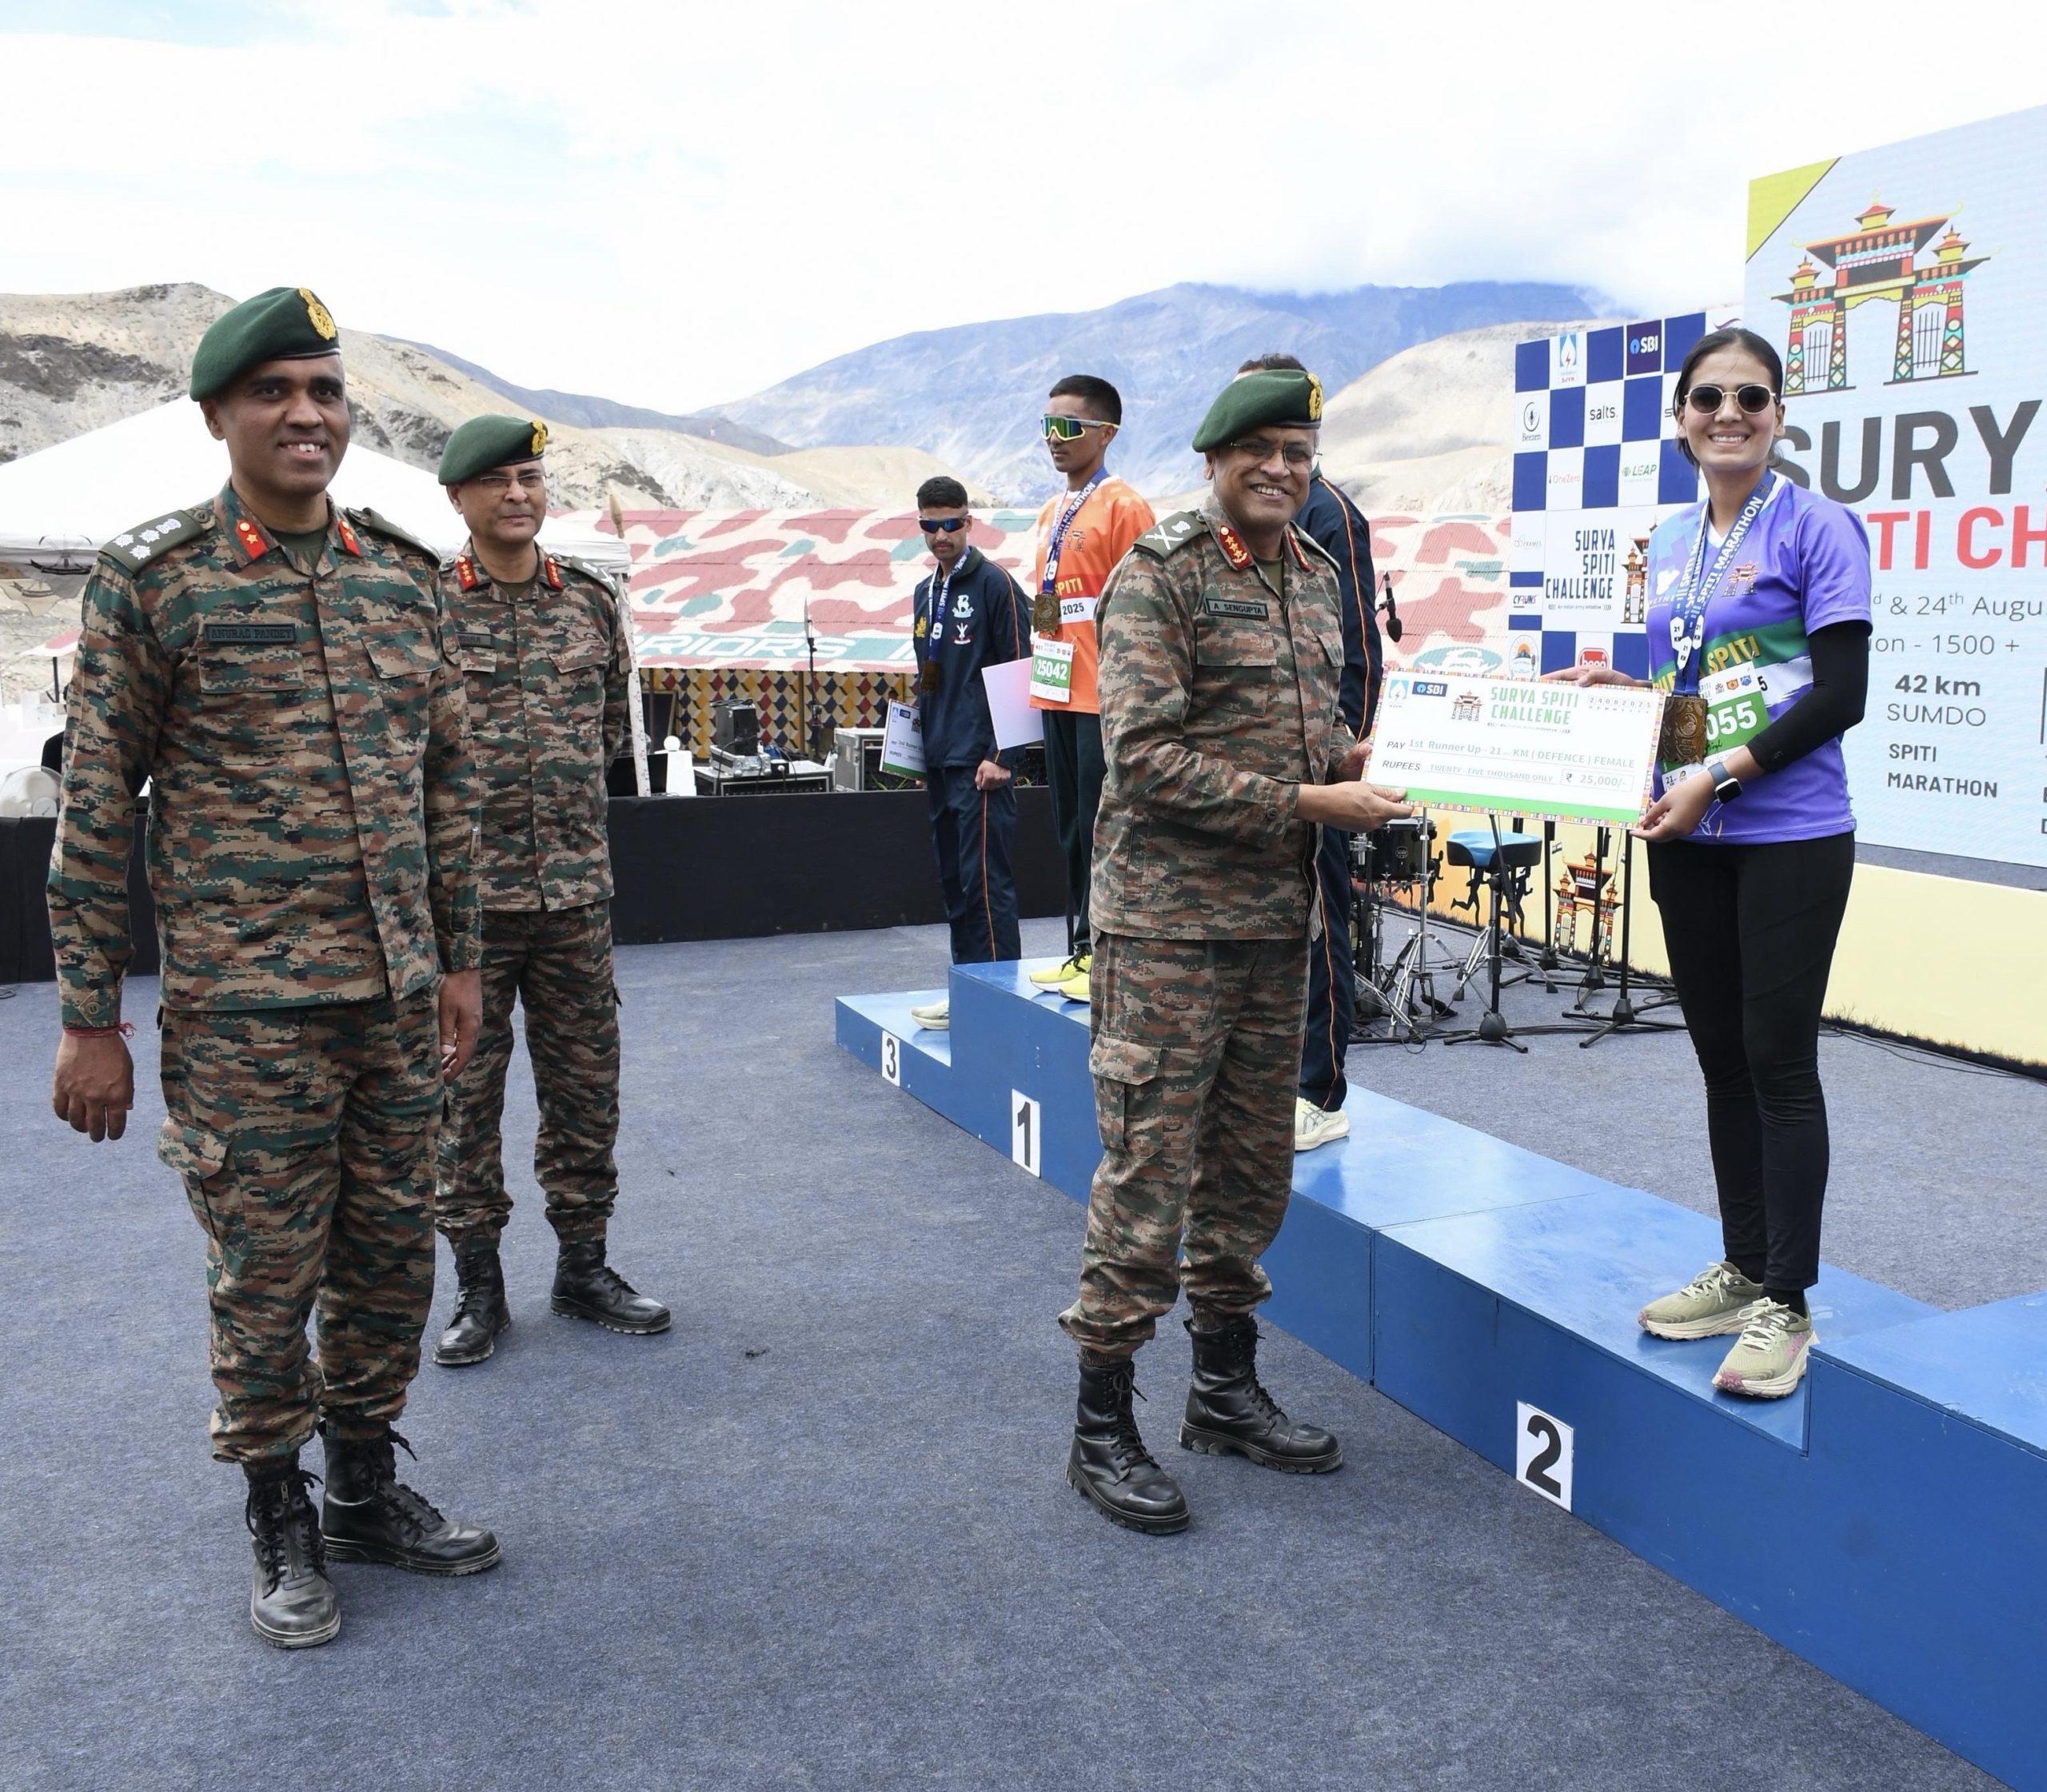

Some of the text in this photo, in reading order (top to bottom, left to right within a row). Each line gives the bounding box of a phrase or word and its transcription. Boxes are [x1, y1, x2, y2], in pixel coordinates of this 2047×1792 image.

[1641, 335, 1659, 353] SBI
[1773, 399, 2047, 505] SURY
[1633, 465, 1658, 476] LEAP
[1063, 481, 1096, 524] MARATHON
[1575, 529, 1615, 551] SURYA
[1698, 496, 1764, 604] SPITI MARATHON
[1582, 553, 1615, 575] SPITI
[1546, 577, 1614, 600] CHALLENGE
[1062, 602, 1085, 615] 2025
[1224, 604, 1263, 615] SENGUPTA
[1890, 597, 1908, 615] &
[1917, 592, 1964, 616] 24th
[1972, 596, 2047, 621] Augu
[1707, 635, 1761, 675] SPITI
[1933, 634, 1995, 655] 1500
[1037, 658, 1068, 680] 25042
[1427, 684, 1443, 695] SBI
[1895, 674, 1981, 696] 42 km
[1490, 686, 1579, 708] SURYA SPITI
[1491, 704, 1571, 725] CHALLENGE
[1887, 703, 1986, 727] SUMDO
[1387, 740, 1407, 749] PAY
[1409, 739, 1423, 748] 1st
[1428, 740, 1465, 752] Runner
[1467, 744, 1481, 755] Up
[1490, 747, 1502, 756] 21
[1513, 748, 1529, 758] KM
[1537, 751, 1585, 764] DEFENCE
[1594, 756, 1635, 768] FEMALE
[1889, 744, 1937, 762] SPITI
[1382, 760, 1421, 771] RUPEES
[1431, 764, 1462, 773] TWENTY
[1486, 769, 1530, 780] THOUSAND
[1887, 772, 1998, 799] MARATHON
[886, 1037, 896, 1079] 3
[1017, 1101, 1031, 1168] 1
[1525, 1415, 1562, 1499] 2
